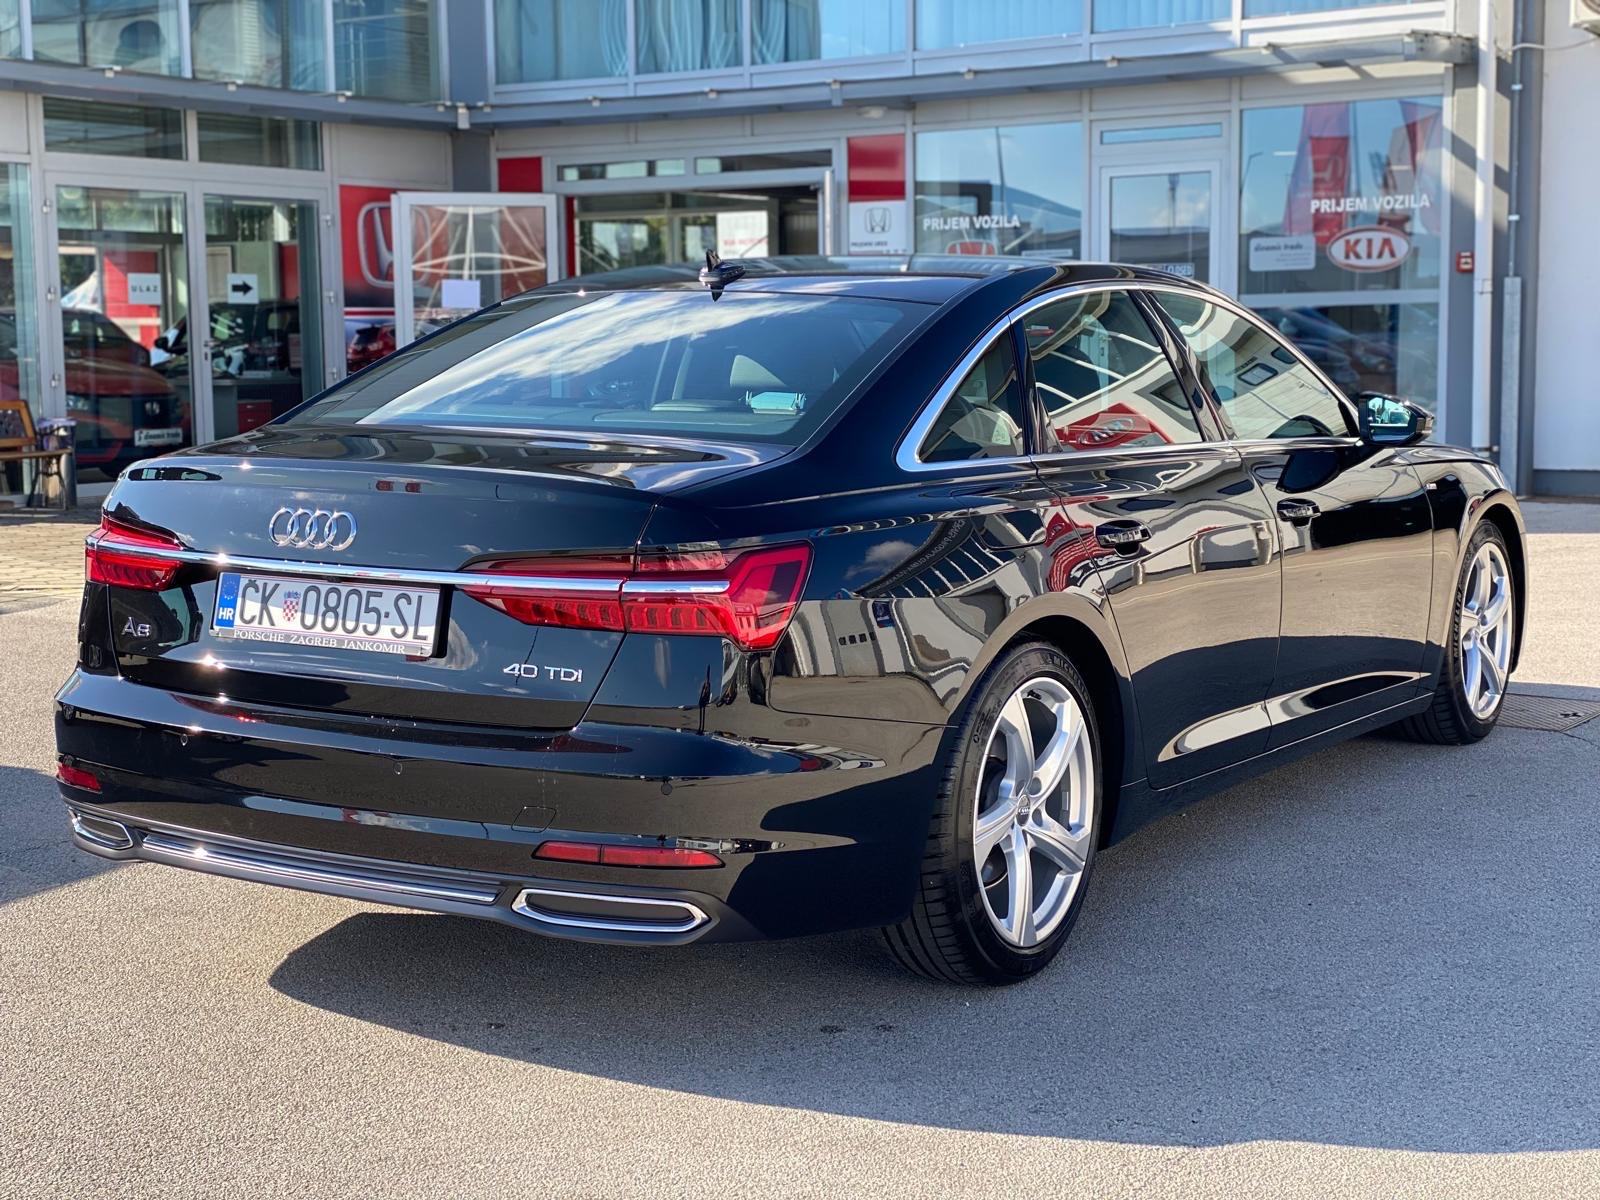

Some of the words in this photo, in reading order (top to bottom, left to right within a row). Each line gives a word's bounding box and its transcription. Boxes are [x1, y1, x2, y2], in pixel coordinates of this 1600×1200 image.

[1310, 197, 1367, 213] PRIJEM
[1373, 194, 1430, 210] VOZILA
[923, 217, 970, 230] PRIJEM
[973, 215, 1020, 229] VOZILA
[1344, 237, 1397, 260] KIA
[239, 579, 280, 626] ČK
[219, 607, 234, 620] HR
[233, 630, 285, 643] PORSCHE
[290, 633, 337, 648] ZAGREB
[341, 639, 406, 655] JANKOMIR
[503, 663, 538, 678] 40
[544, 666, 583, 683] TDI
